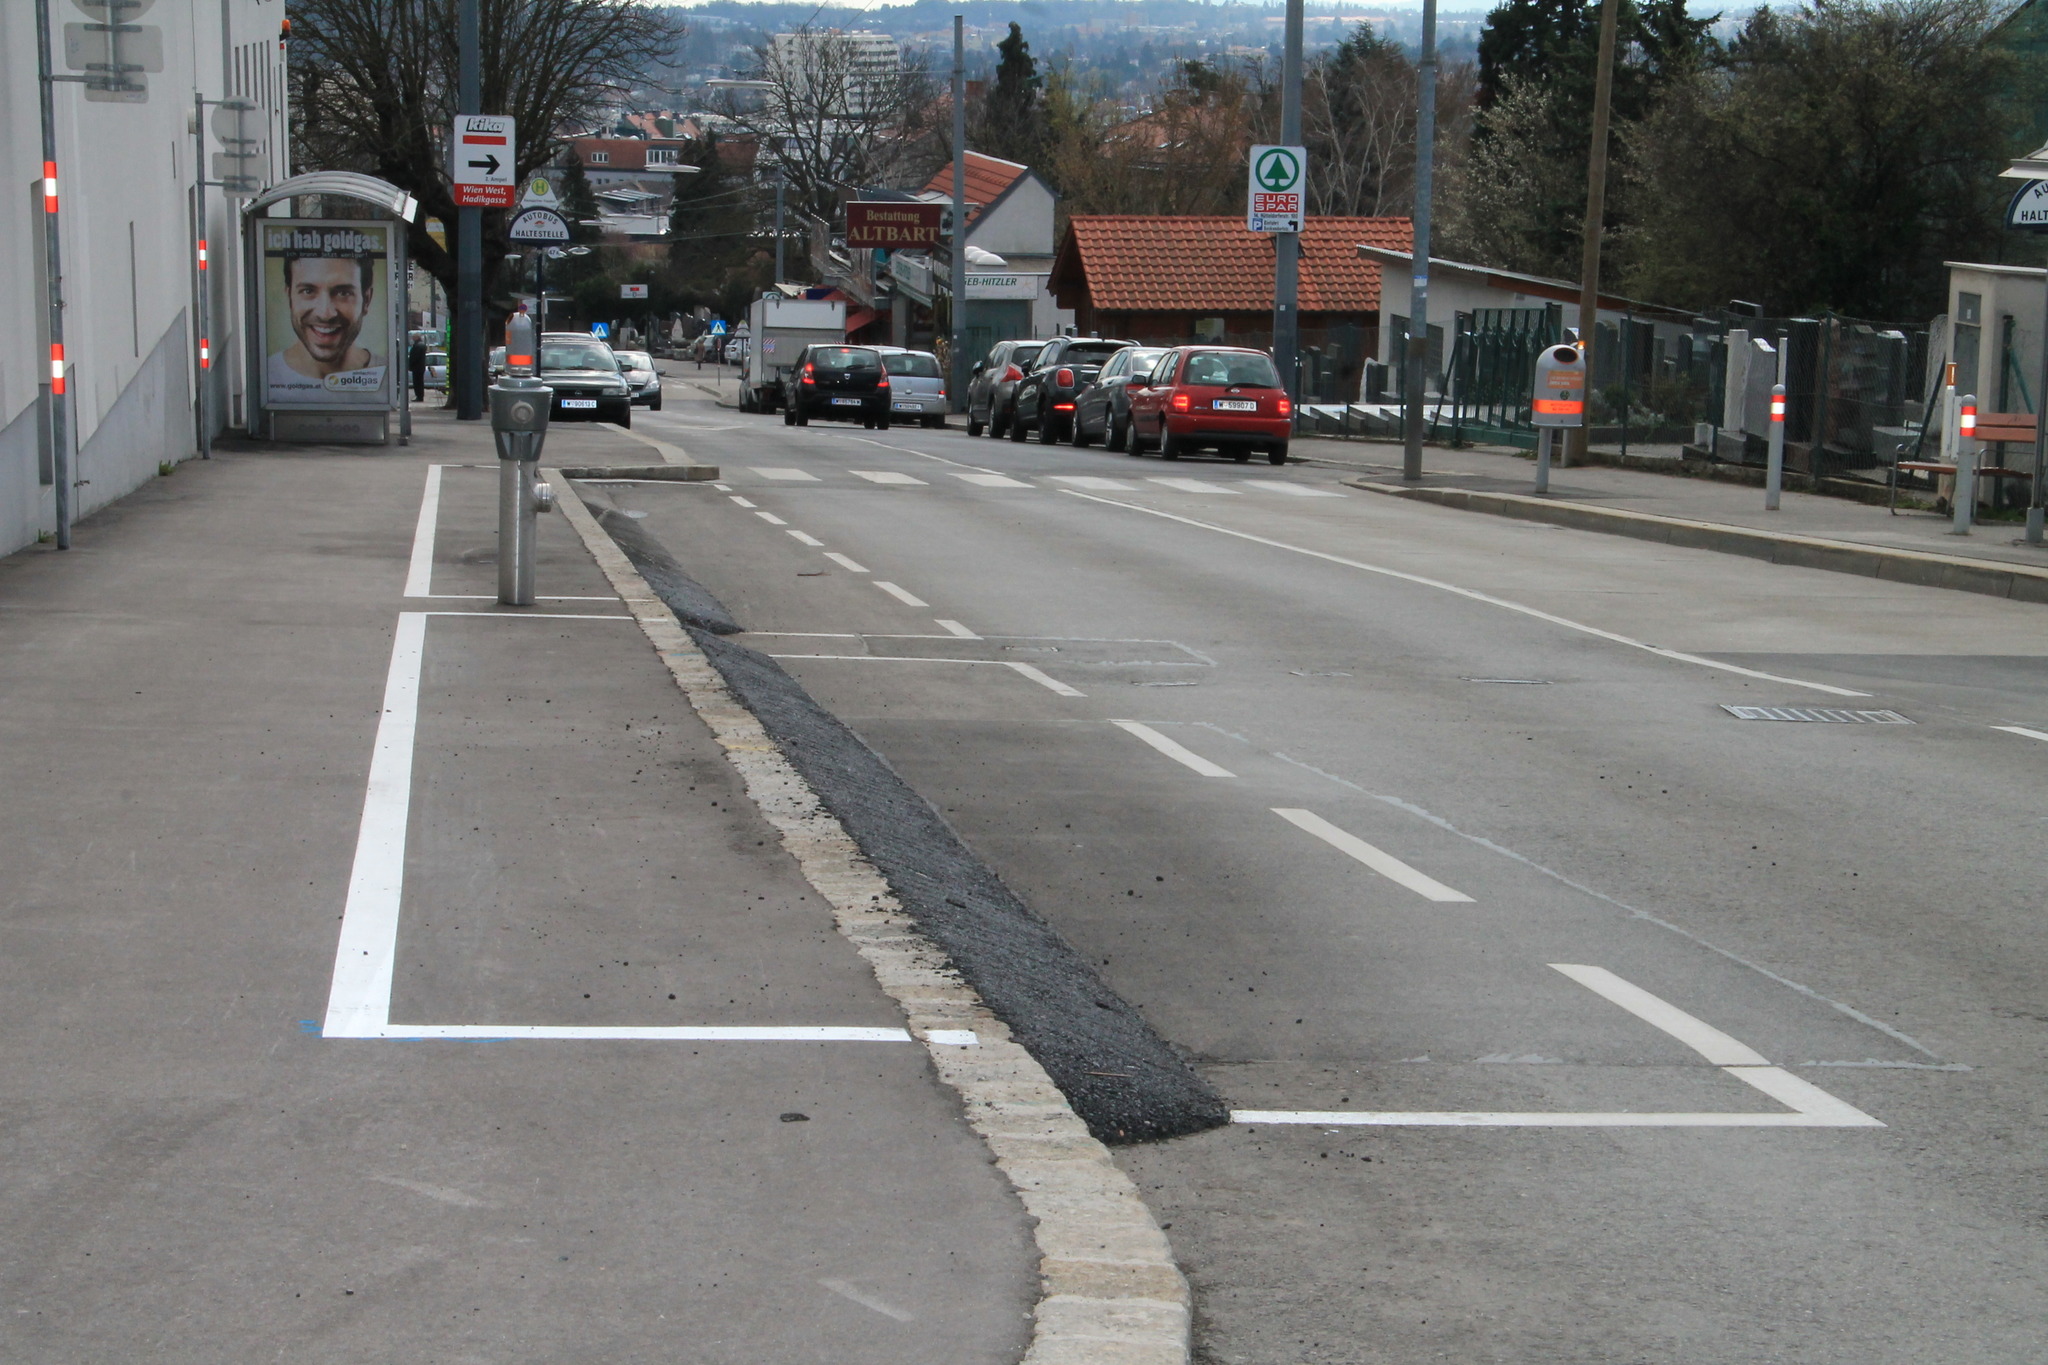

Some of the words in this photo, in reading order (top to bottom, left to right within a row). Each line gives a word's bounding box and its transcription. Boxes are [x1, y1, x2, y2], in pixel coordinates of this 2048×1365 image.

[466, 118, 505, 133] kika
[463, 185, 483, 194] Wien
[485, 186, 506, 195] West,
[536, 182, 545, 193] H
[462, 195, 507, 205] Hadikgasse
[1255, 194, 1298, 203] EURO
[1255, 203, 1298, 211] SPAR
[522, 211, 558, 225] AUTOBUS
[866, 209, 920, 224] Bestattung
[515, 230, 564, 239] HALTESTELLE
[848, 226, 939, 242] ALTBART
[267, 229, 291, 249] ich
[293, 229, 321, 249] hab
[323, 230, 384, 253] goldgas.
[340, 376, 378, 386] goldgas
